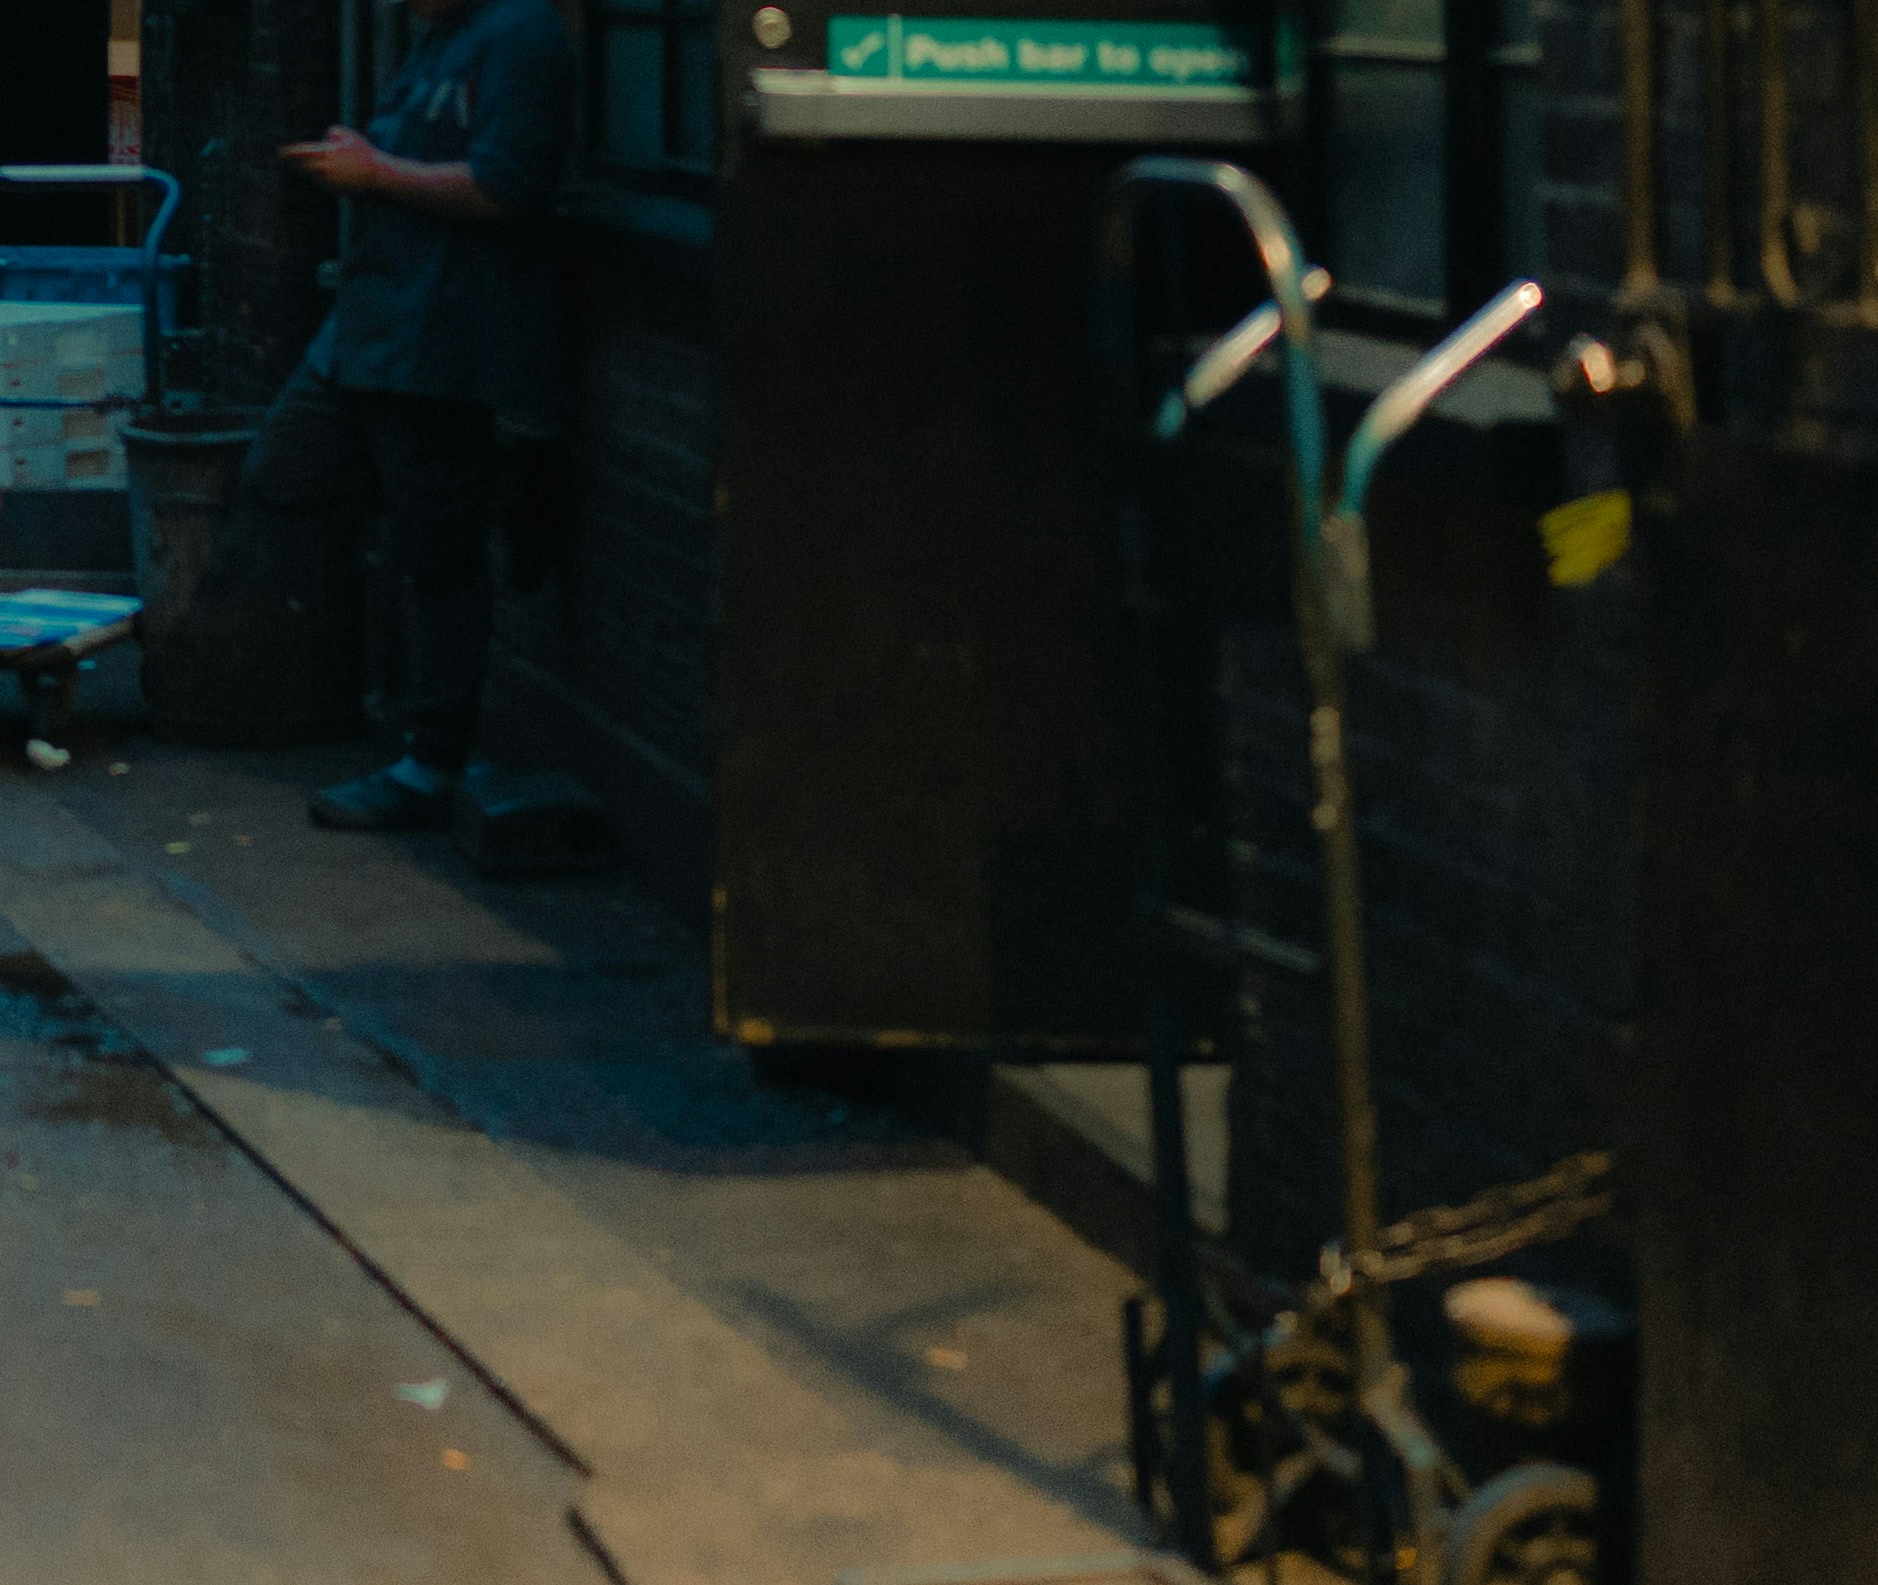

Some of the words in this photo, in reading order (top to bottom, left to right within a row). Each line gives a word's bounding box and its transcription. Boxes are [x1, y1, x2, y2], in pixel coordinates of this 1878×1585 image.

[905, 32, 1011, 73] Push
[1015, 37, 1088, 74] bar
[1096, 39, 1142, 75] to
